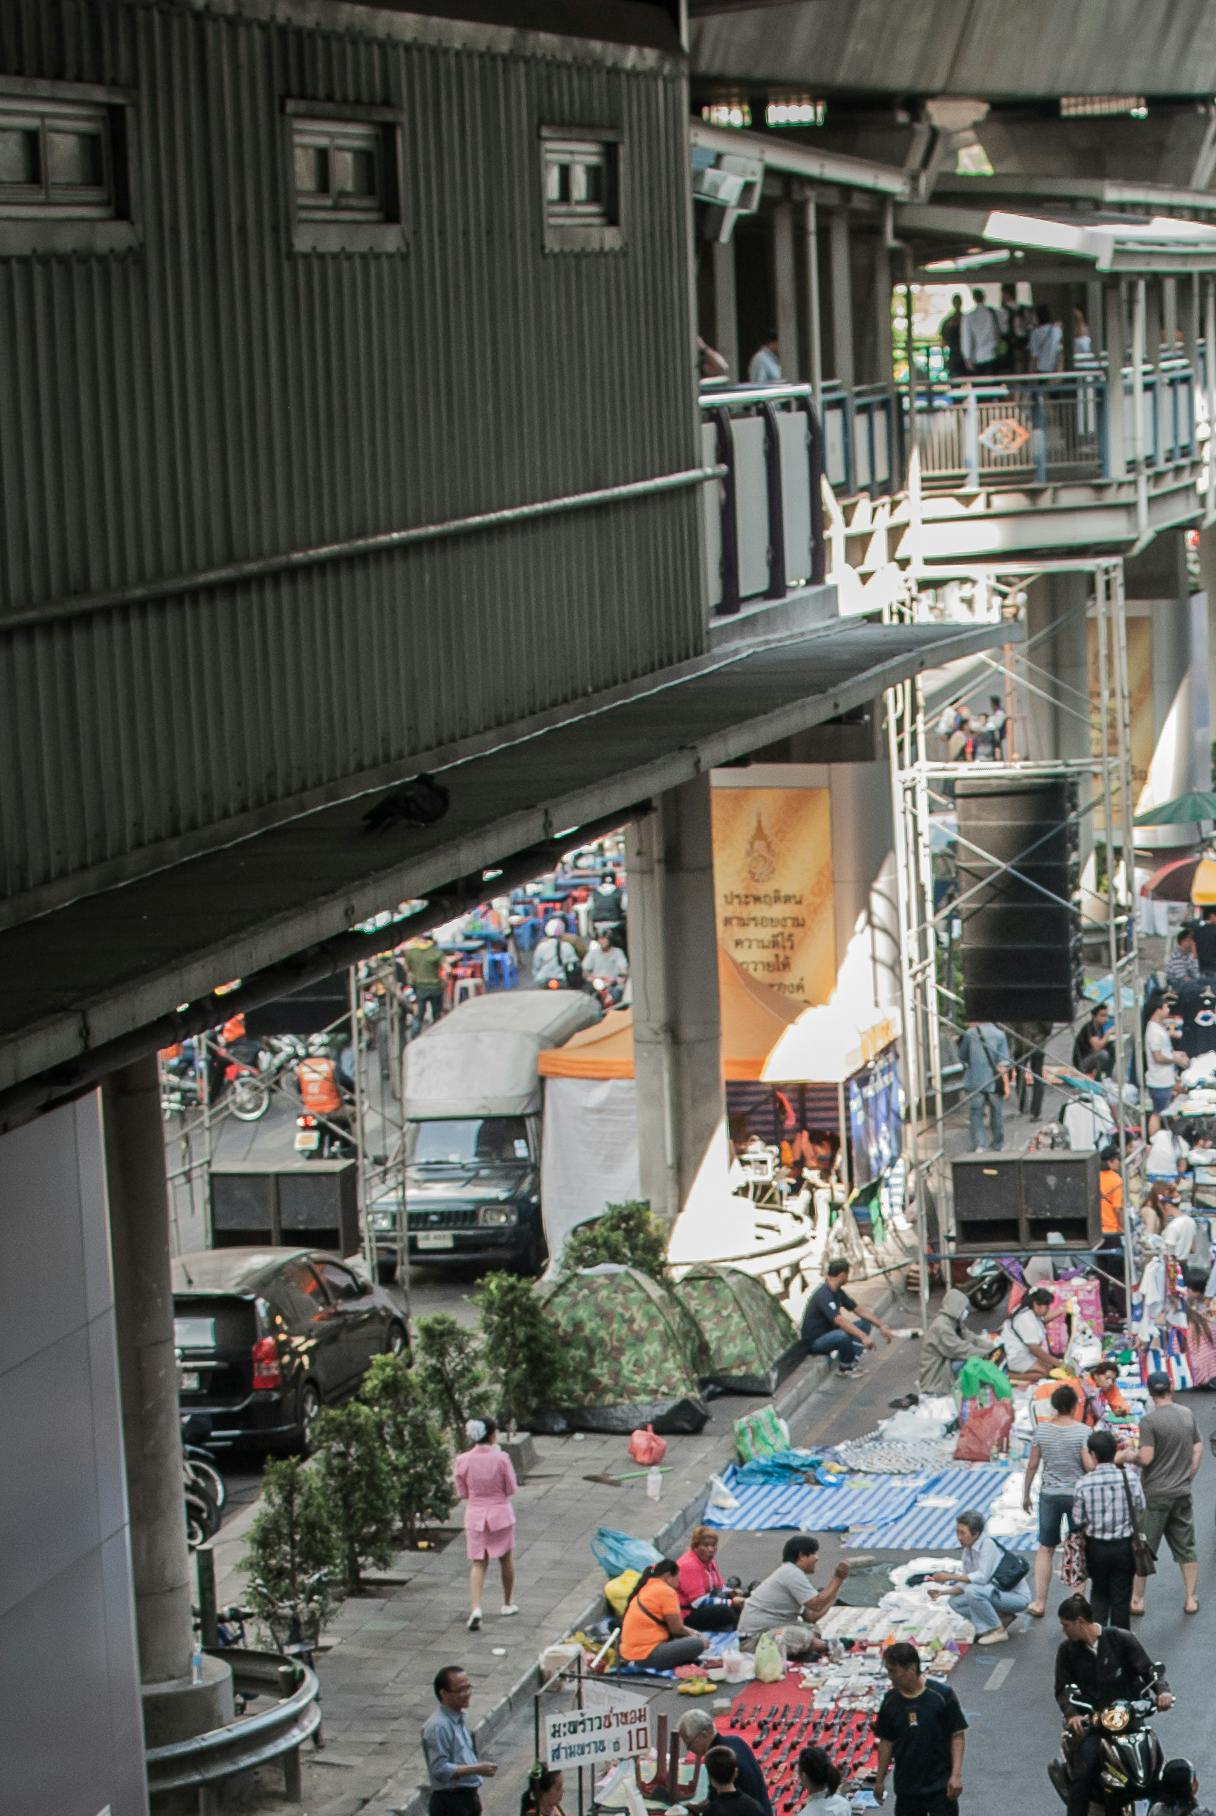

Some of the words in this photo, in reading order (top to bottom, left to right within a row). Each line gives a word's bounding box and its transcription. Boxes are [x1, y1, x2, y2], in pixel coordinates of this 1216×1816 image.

[723, 889, 803, 910] ประพฤติตน
[627, 1727, 649, 1752] 10
